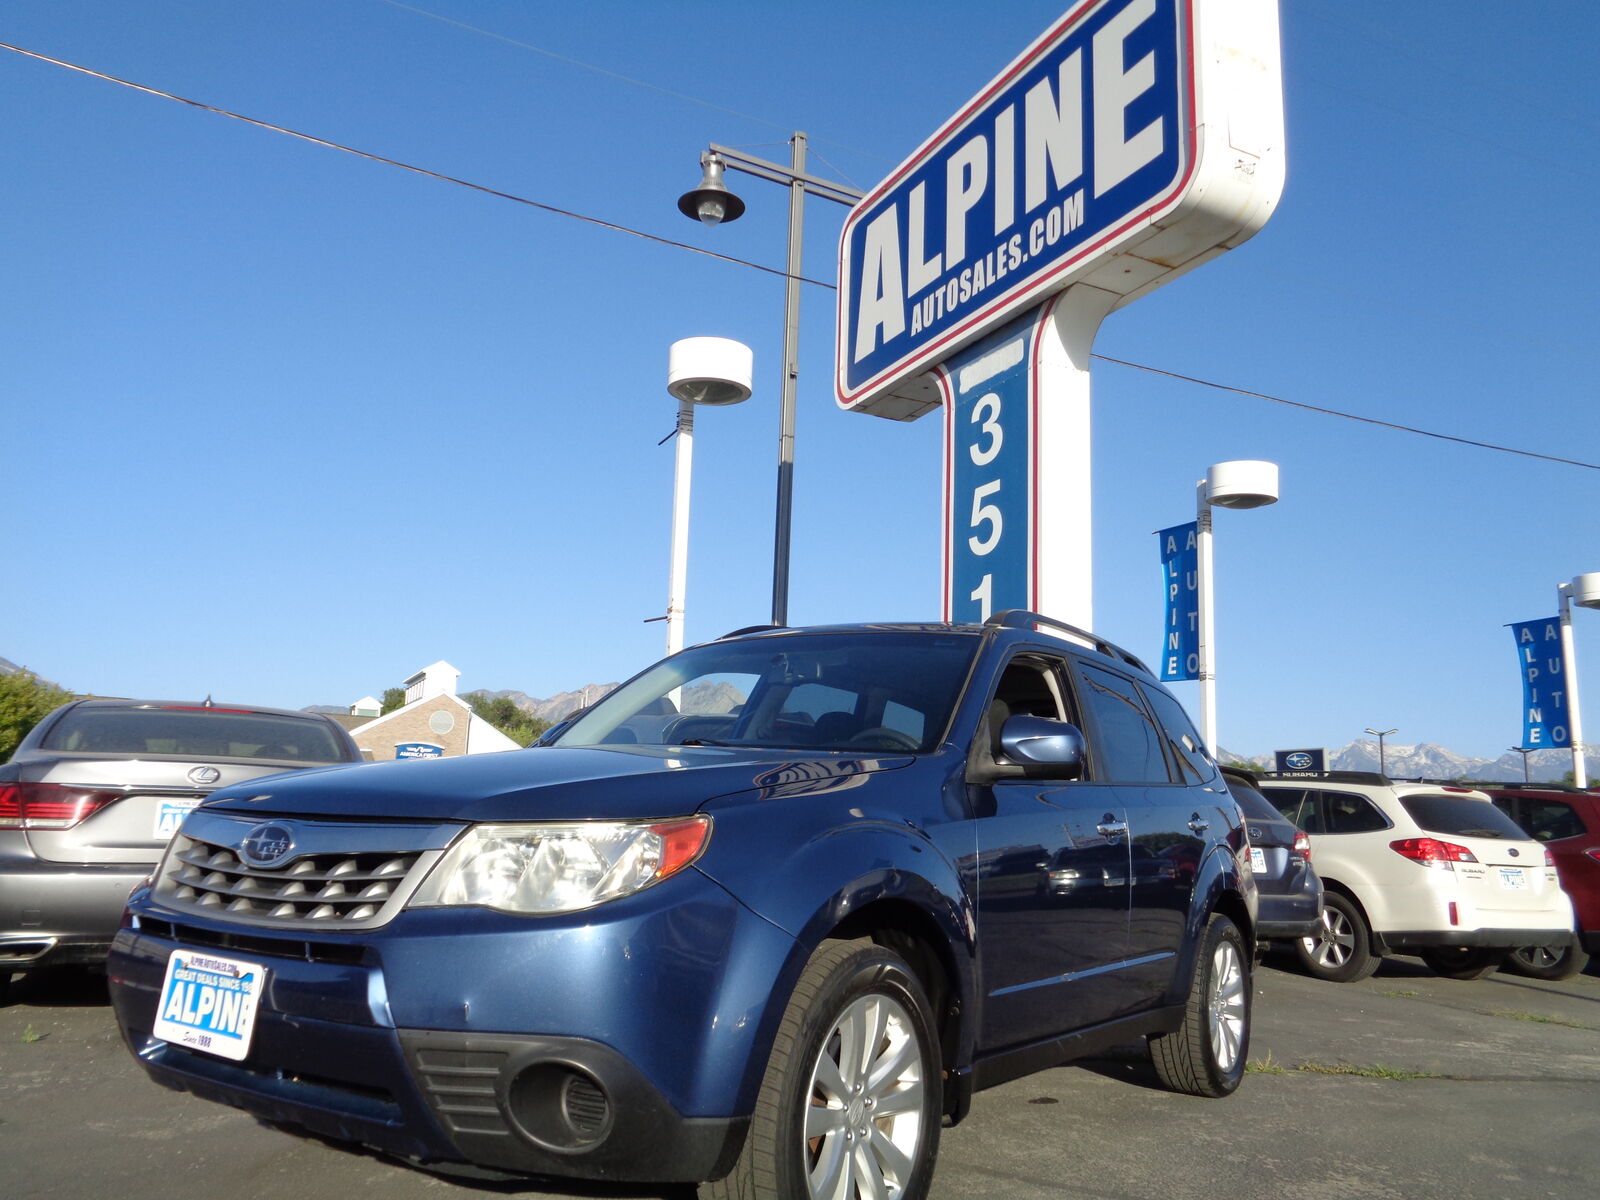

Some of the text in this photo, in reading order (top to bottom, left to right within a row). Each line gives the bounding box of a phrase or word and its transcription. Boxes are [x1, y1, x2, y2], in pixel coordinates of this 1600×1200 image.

[854, 0, 1164, 364] ALPINE
[910, 189, 1084, 338] AUTOSALES.COM
[1166, 536, 1179, 675] ALPINE
[1185, 530, 1199, 674] AUTO
[1520, 628, 1542, 743] ALPINE
[1545, 624, 1567, 742] AUTO
[164, 981, 251, 1037] ALPINE
